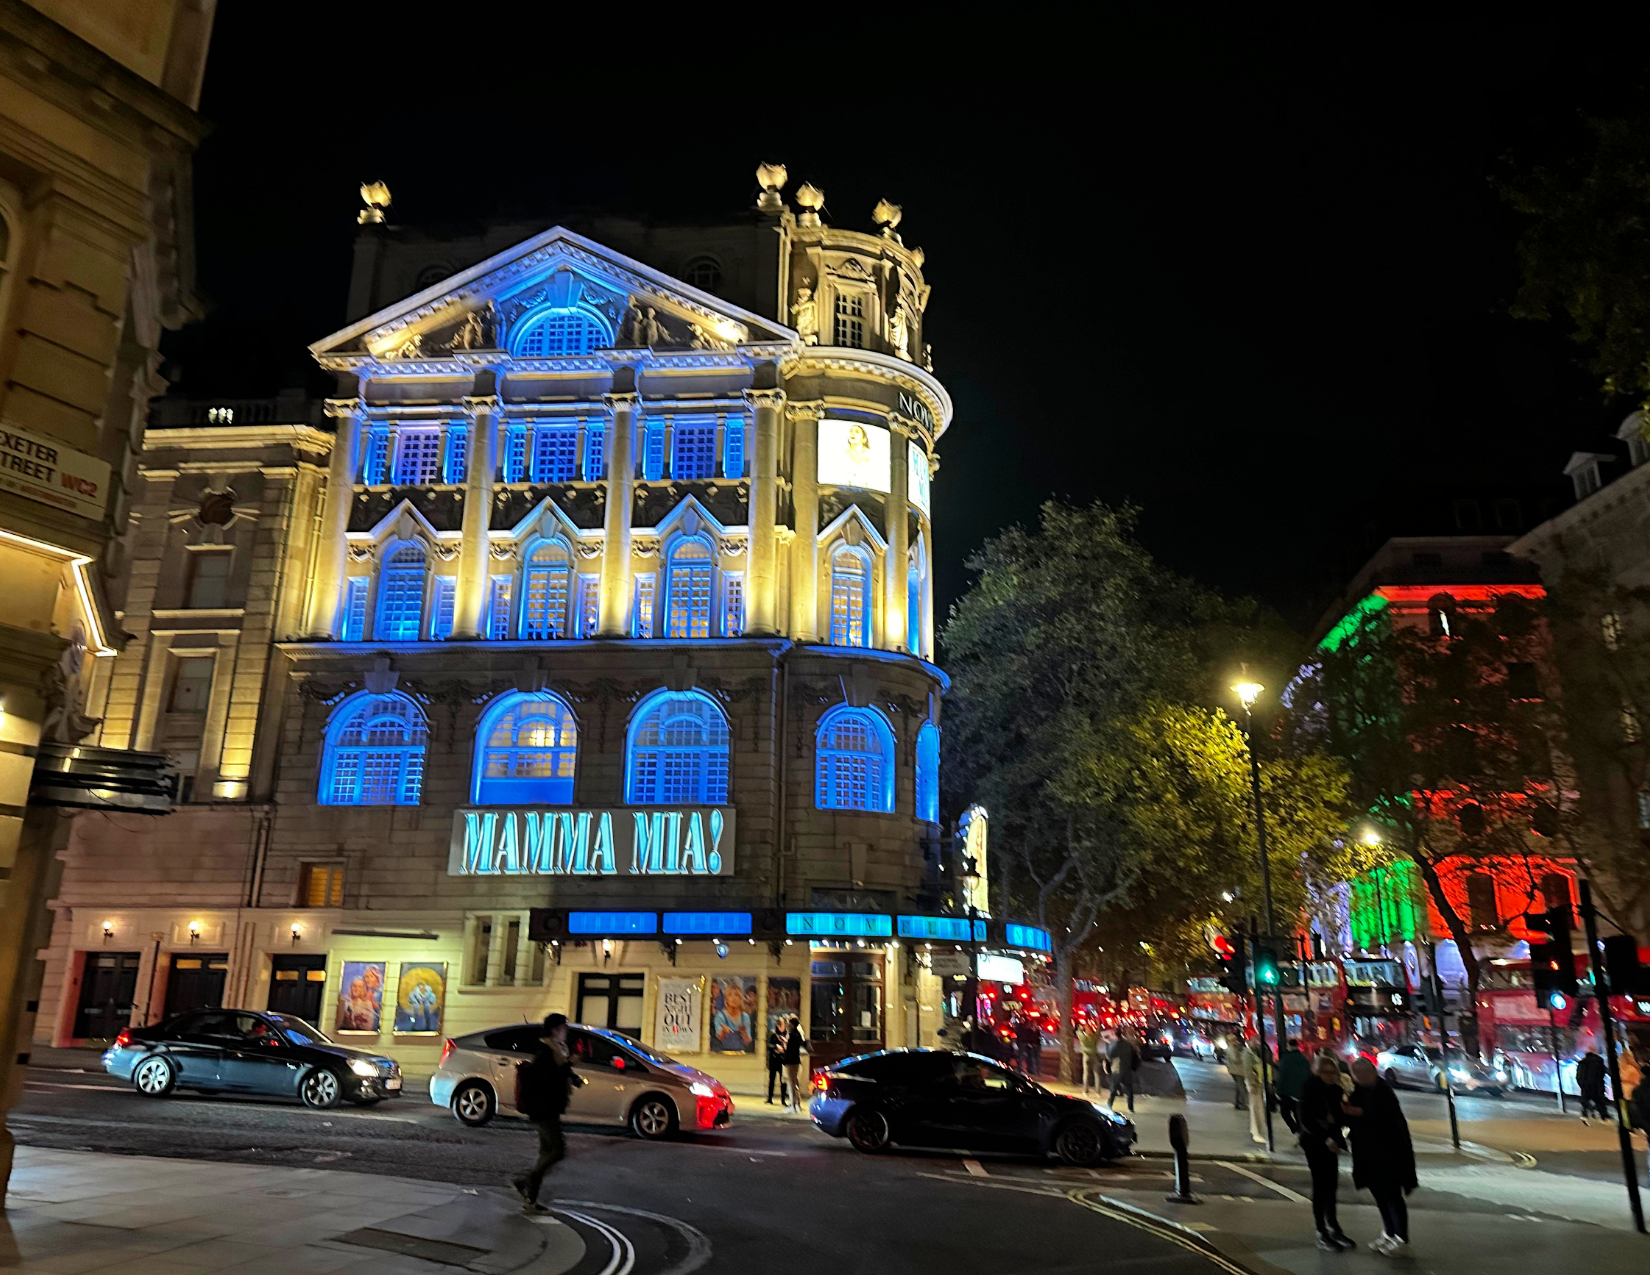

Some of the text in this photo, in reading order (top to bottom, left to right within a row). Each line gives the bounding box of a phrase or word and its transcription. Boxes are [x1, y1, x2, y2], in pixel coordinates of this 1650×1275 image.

[0, 430, 57, 465] EXETER
[0, 450, 56, 483] TREET
[458, 809, 724, 875] MAMMA MIA!
[664, 1014, 691, 1026] OUT
